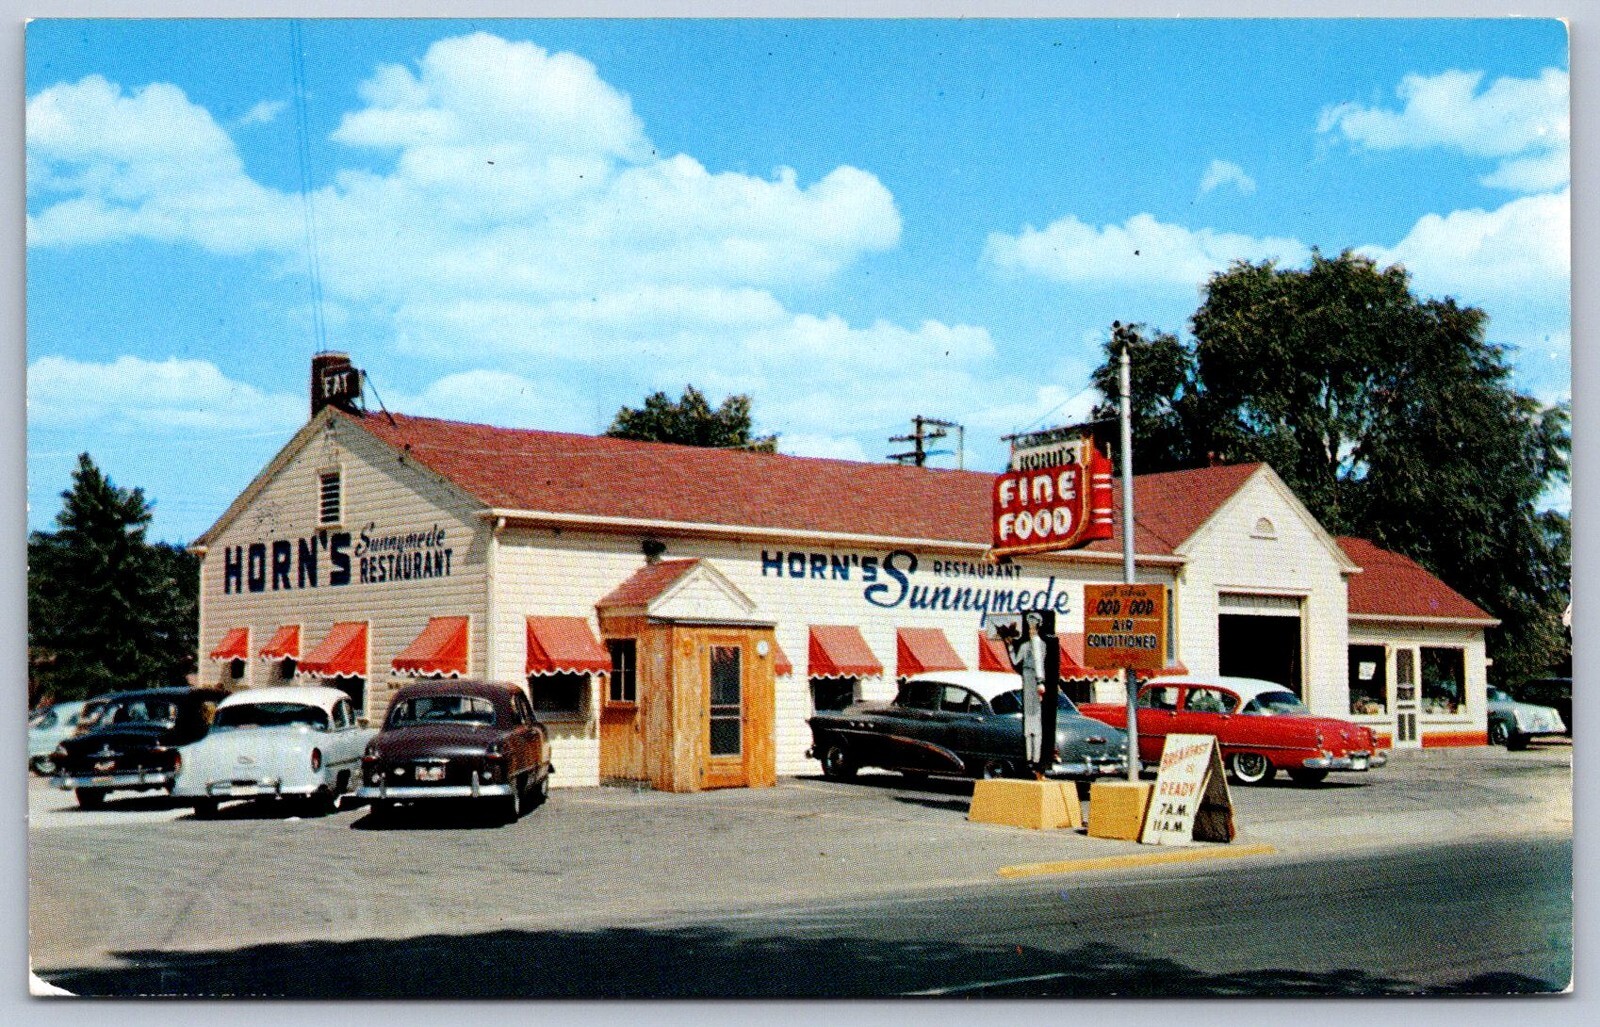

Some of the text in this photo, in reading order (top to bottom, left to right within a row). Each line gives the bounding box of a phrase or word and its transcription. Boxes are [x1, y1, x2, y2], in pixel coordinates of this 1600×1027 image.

[998, 470, 1076, 509] FINE
[354, 521, 446, 557] Sunnymede
[998, 506, 1072, 541] FOOD
[224, 529, 352, 595] HORN'S
[359, 548, 453, 584] RESTAURANT
[761, 550, 879, 583] HORN'S
[933, 559, 1022, 579] RESTAURANT
[863, 550, 1071, 628] Sunnymede
[1087, 633, 1157, 649] CONDITIONED
[1111, 619, 1134, 632] AIR
[1160, 781, 1196, 797] READY
